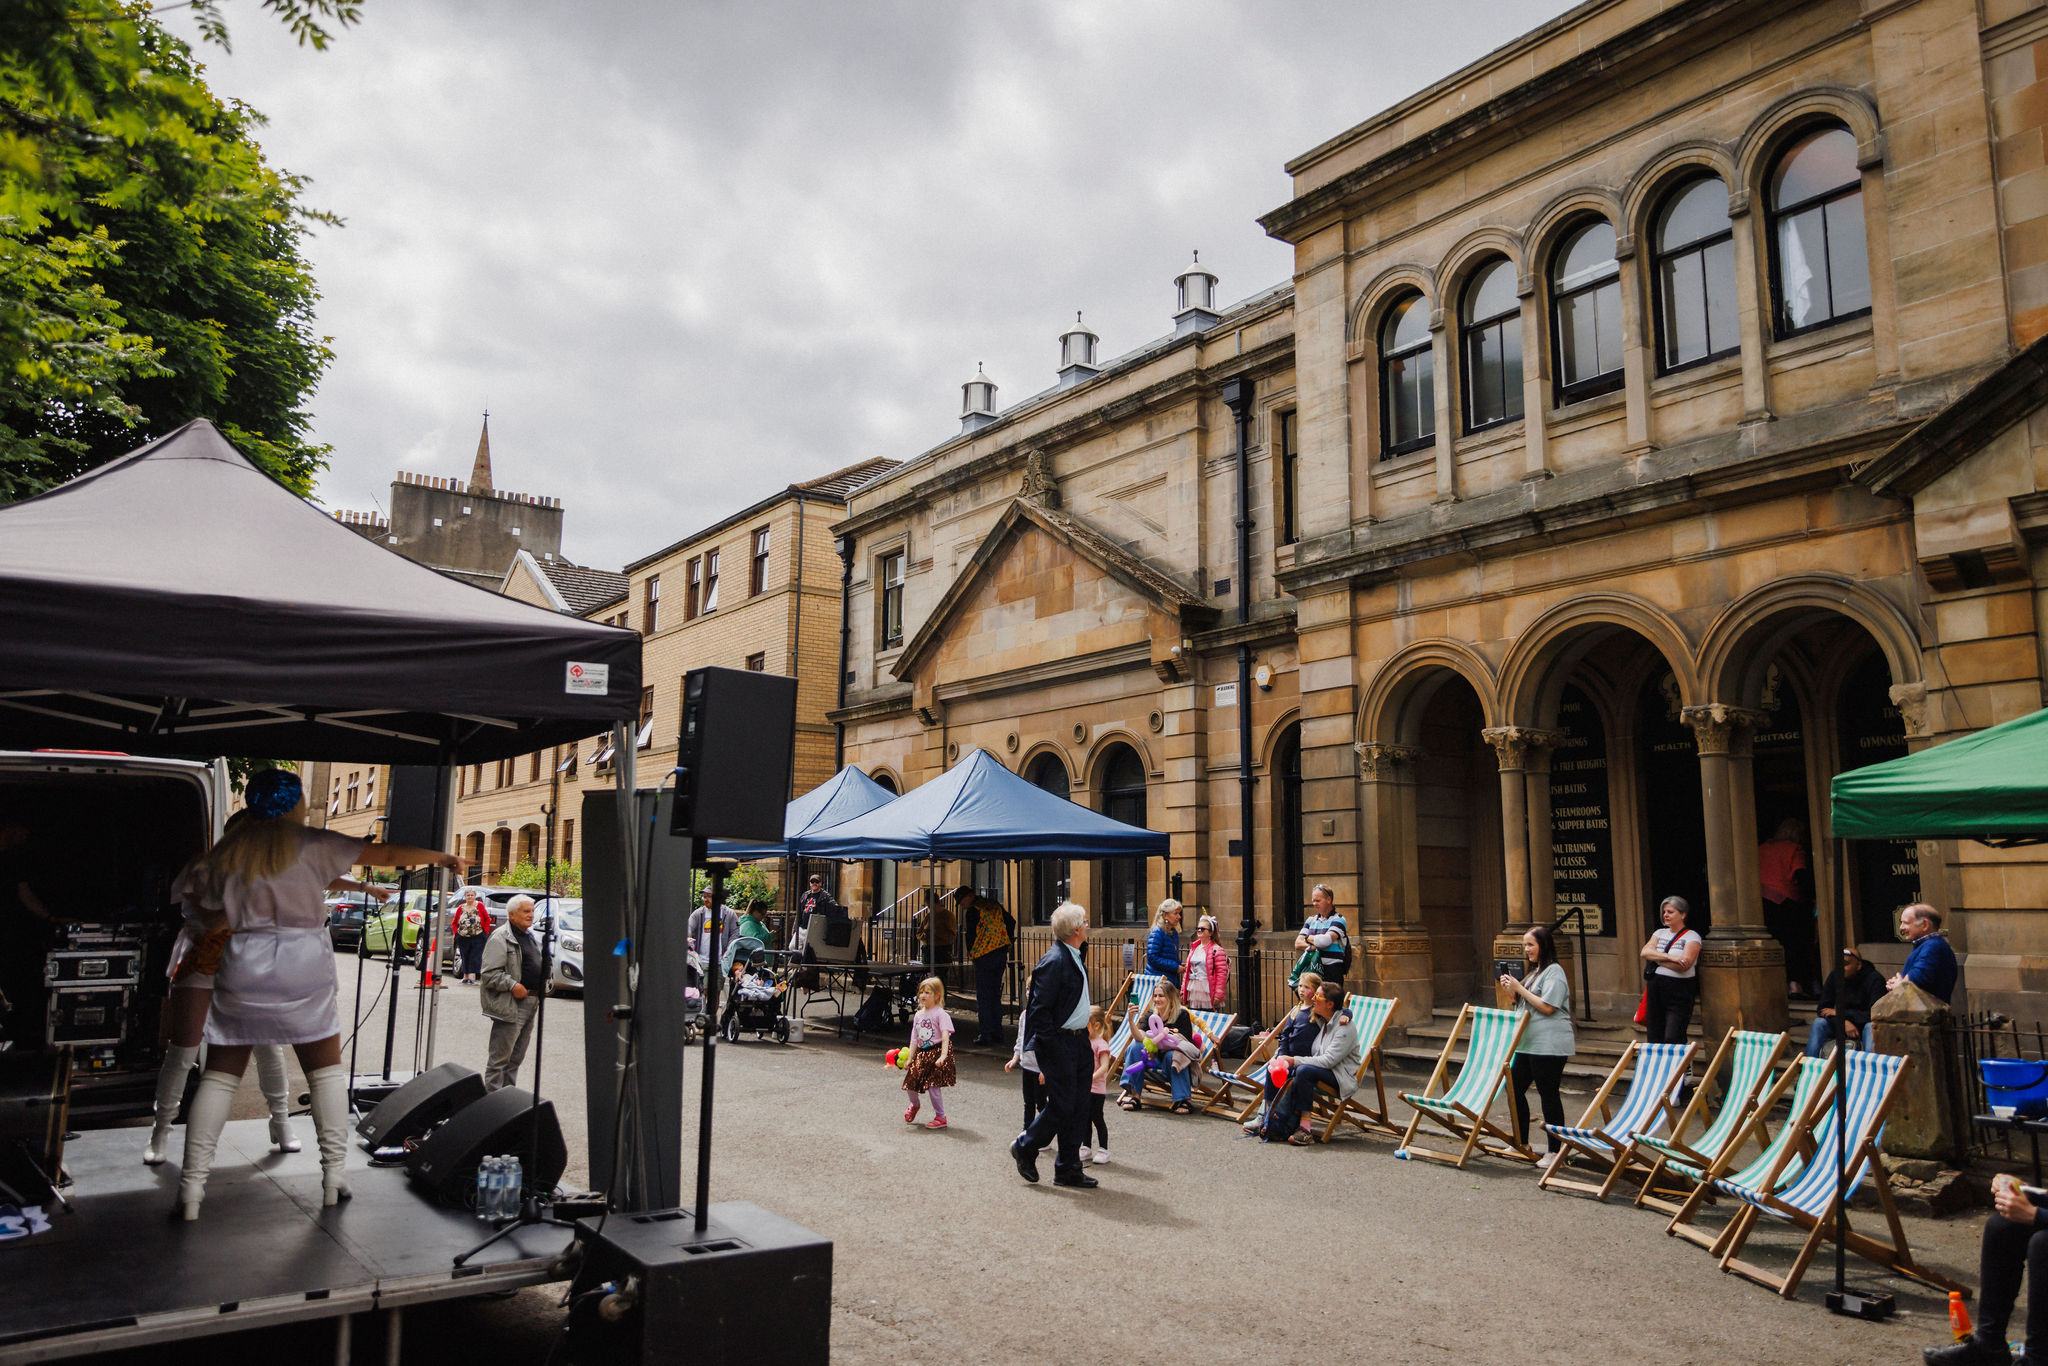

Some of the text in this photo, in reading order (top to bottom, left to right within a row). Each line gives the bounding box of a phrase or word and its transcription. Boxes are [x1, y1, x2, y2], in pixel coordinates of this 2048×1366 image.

[1653, 741, 1691, 752] HEALTH
[1576, 759, 1607, 769] WEIGHTS
[1565, 784, 1587, 794] BATHS
[1555, 806, 1601, 817] STEAMROOMS
[1558, 819, 1585, 830] SLIPPER
[1586, 818, 1608, 829] BATHS
[1565, 842, 1596, 853] TRAINING
[1560, 856, 1587, 867] CLASSES
[1569, 869, 1598, 879] LESSONS
[1572, 892, 1586, 903] BAR
